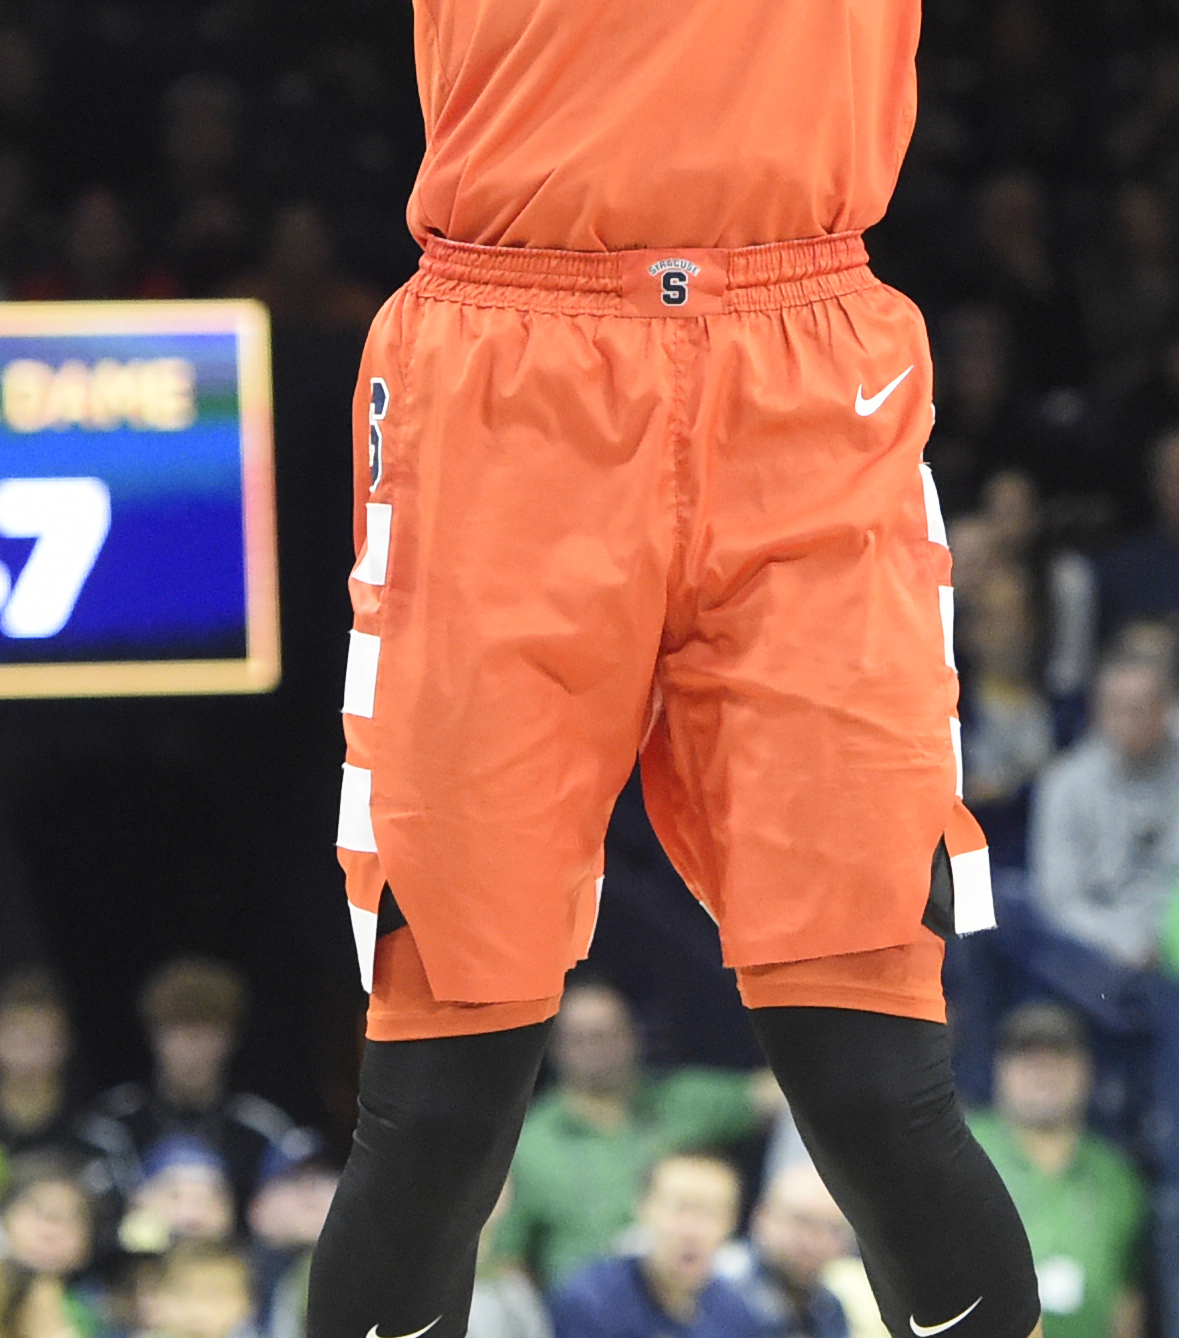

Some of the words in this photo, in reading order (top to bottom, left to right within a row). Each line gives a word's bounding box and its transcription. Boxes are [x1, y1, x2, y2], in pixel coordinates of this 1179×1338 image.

[648, 258, 701, 277] SYRACUSE
[661, 270, 689, 307] S
[3, 357, 195, 431] DAME
